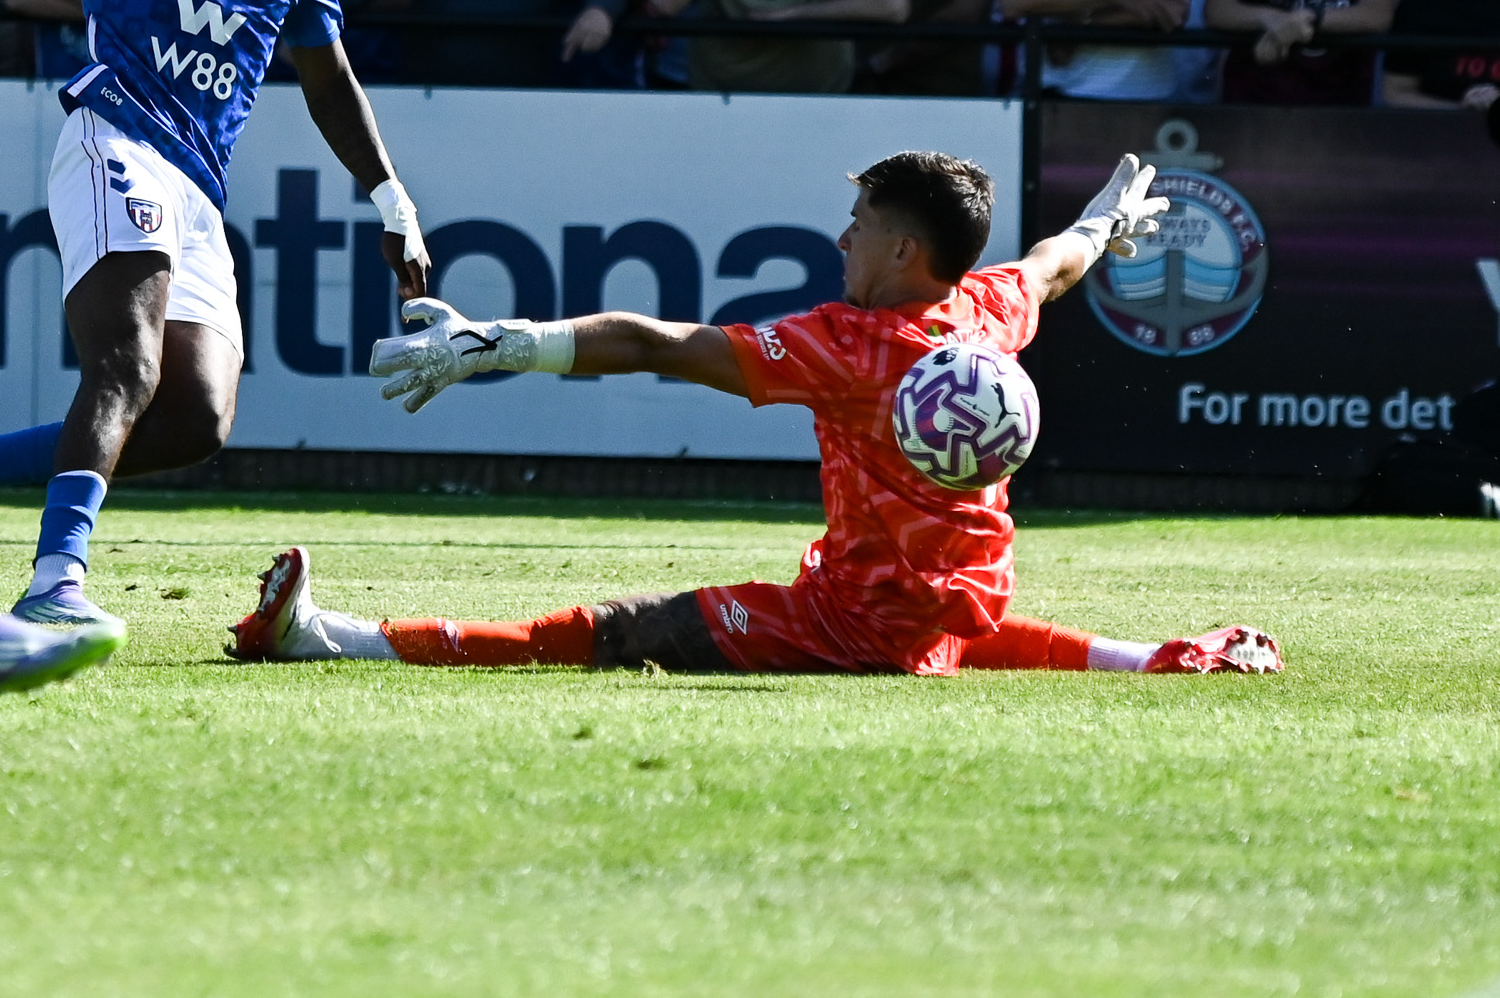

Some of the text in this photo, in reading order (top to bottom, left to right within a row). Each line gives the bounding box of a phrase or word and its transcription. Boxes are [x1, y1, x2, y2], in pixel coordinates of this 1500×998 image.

[151, 35, 237, 100] W88
[1178, 383, 1249, 424] For
[1260, 392, 1370, 429] more
[720, 604, 734, 634] umbro
